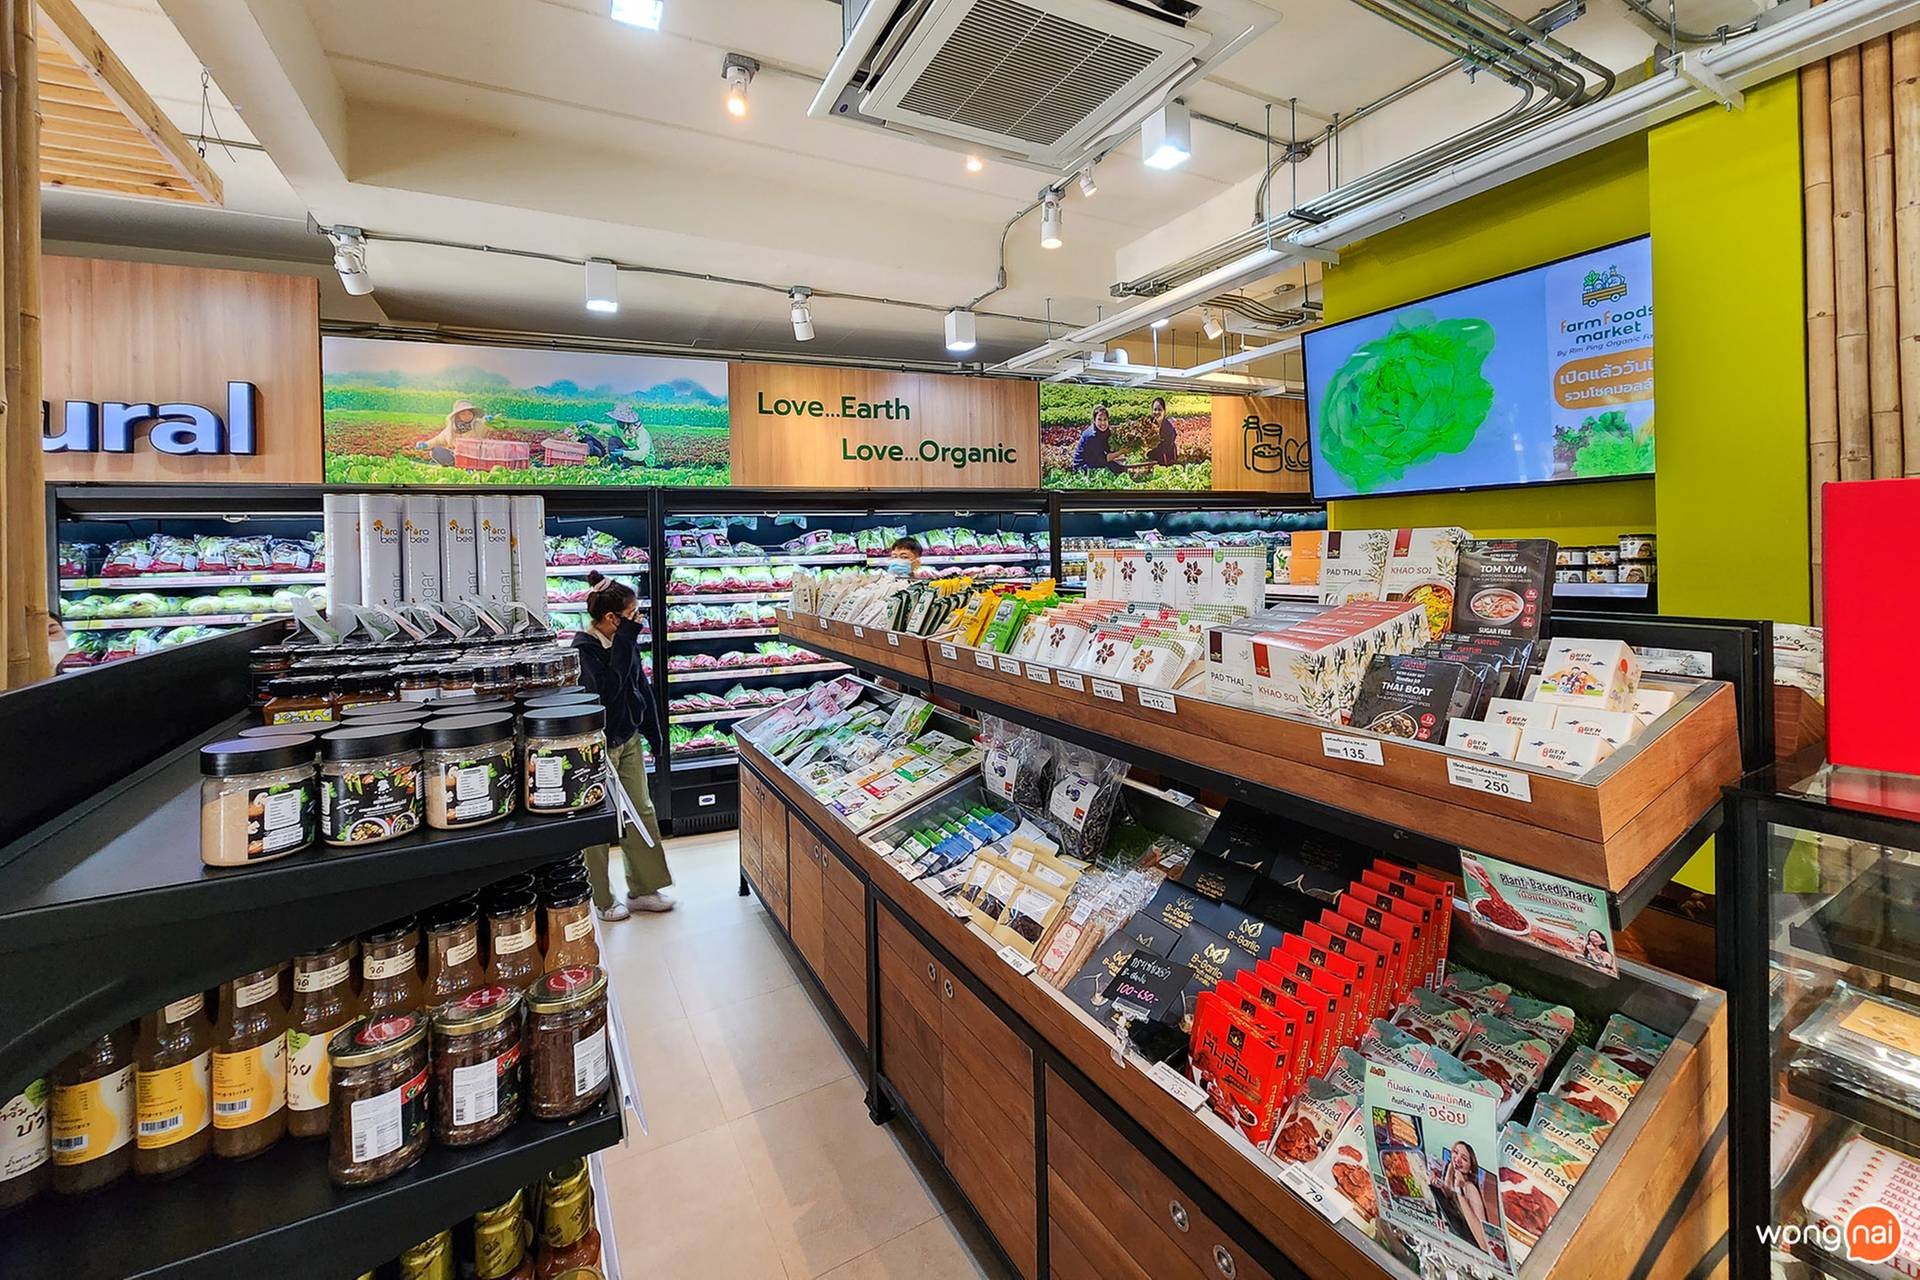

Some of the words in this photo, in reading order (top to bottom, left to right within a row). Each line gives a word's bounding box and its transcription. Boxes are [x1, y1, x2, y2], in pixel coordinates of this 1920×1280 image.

[1560, 318, 1601, 334] farm
[1604, 305, 1653, 325] foods
[1576, 321, 1641, 344] market
[758, 392, 911, 420] Love...Earth
[42, 380, 257, 456] ural
[842, 438, 1017, 468] Love...Organic
[1326, 567, 1341, 576] PAD
[1343, 567, 1362, 576] THAI
[1390, 566, 1414, 575] KHAO
[1416, 567, 1433, 575] SOI
[1480, 565, 1501, 573] TOM
[1503, 565, 1528, 574] YUM
[1478, 627, 1497, 635] SUGAR
[1498, 628, 1512, 636] FREE
[1211, 672, 1225, 682] PAD
[1225, 675, 1244, 686] THAI
[1382, 681, 1403, 691] THAI
[1405, 685, 1433, 696] BOAT
[1258, 686, 1282, 699] KHAO
[1284, 693, 1299, 703] SOI
[1343, 747, 1365, 760] 135
[1484, 779, 1509, 794] 250
[1165, 903, 1193, 922] B-Garlic
[1227, 931, 1260, 952] B-Garlic
[1191, 953, 1223, 979] B-Garlic
[1473, 1033, 1538, 1070] Plant-Based
[1429, 1105, 1466, 1125] อร่อย
[1504, 1143, 1575, 1192] Plant-Base
[1306, 1187, 1323, 1203] 79
